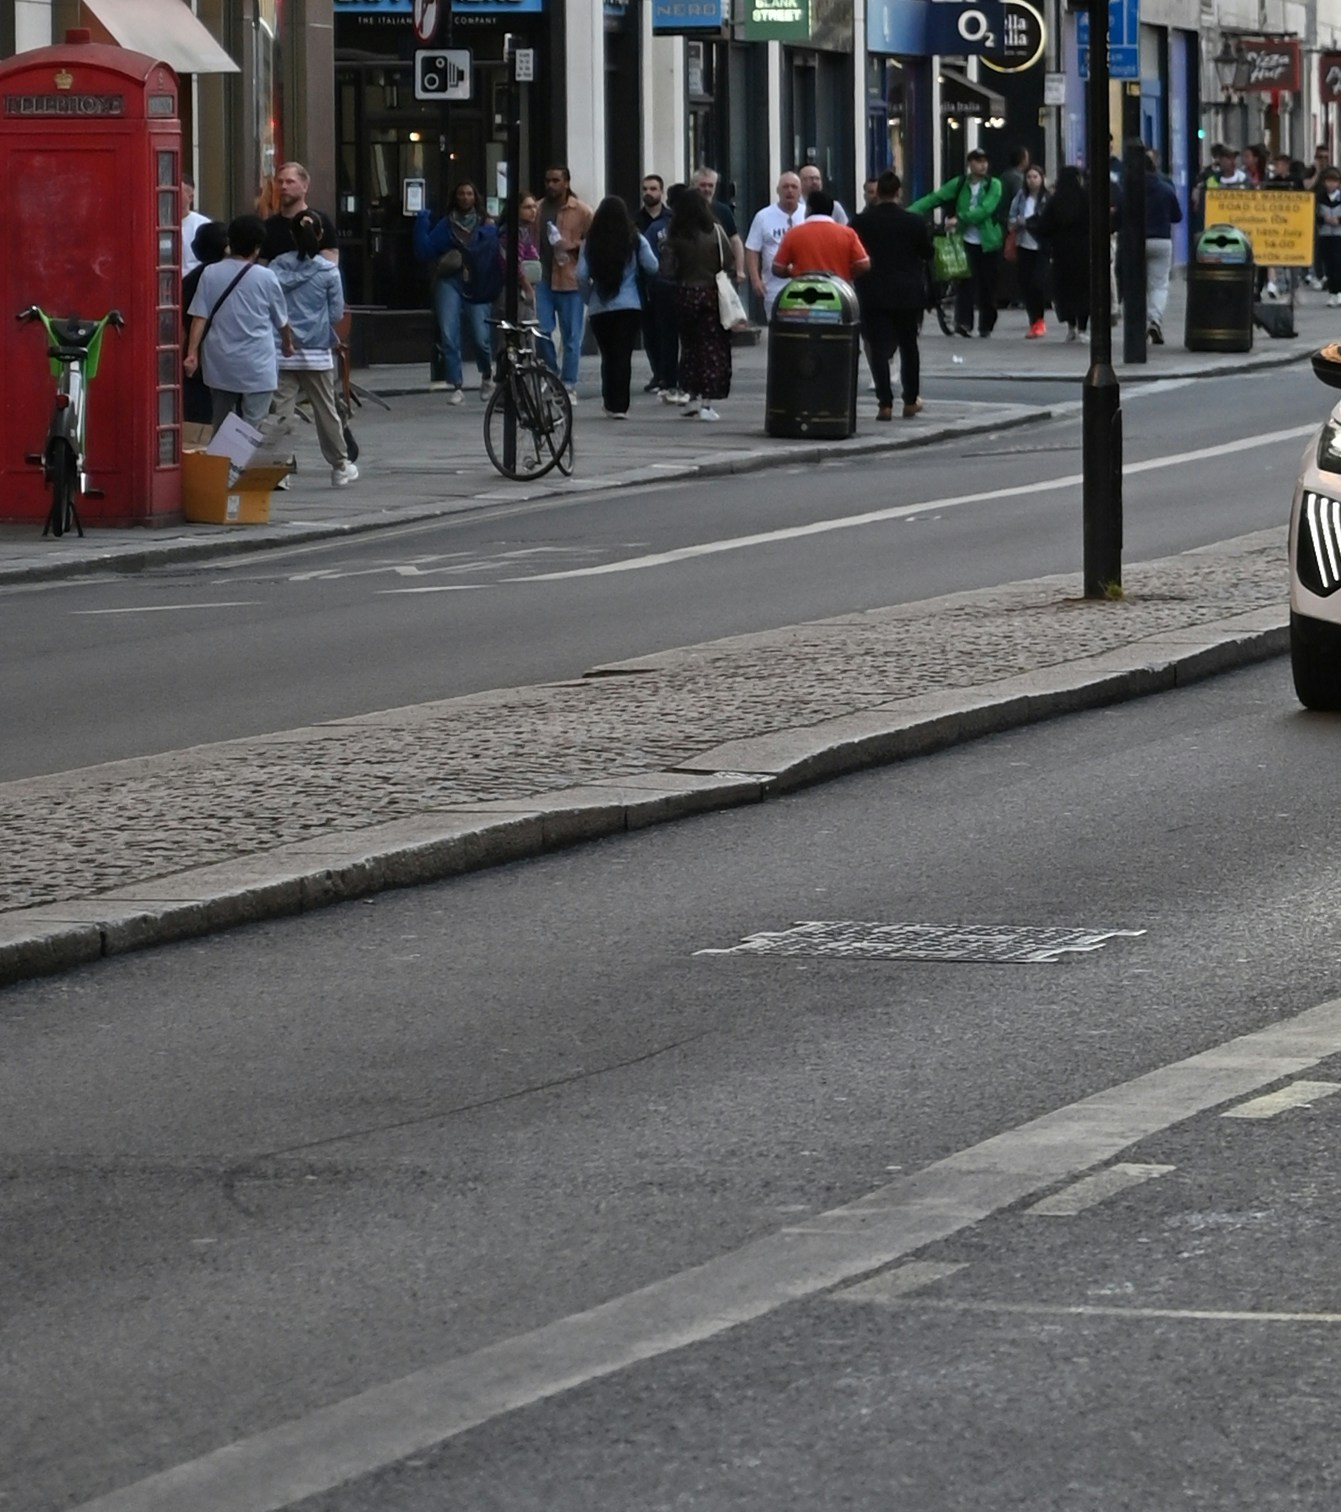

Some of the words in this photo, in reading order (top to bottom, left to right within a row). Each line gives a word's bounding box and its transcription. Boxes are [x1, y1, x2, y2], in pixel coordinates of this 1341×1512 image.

[657, 3, 716, 17] NERO
[752, 9, 801, 22] STREET
[358, 17, 374, 25] THE
[377, 17, 413, 25] ITALIAN
[454, 17, 497, 25] COMPANY
[1247, 51, 1289, 67] Pizza
[1251, 67, 1284, 82] Hut
[1218, 204, 1249, 212] ROAD
[1254, 204, 1300, 213] CLOSED
